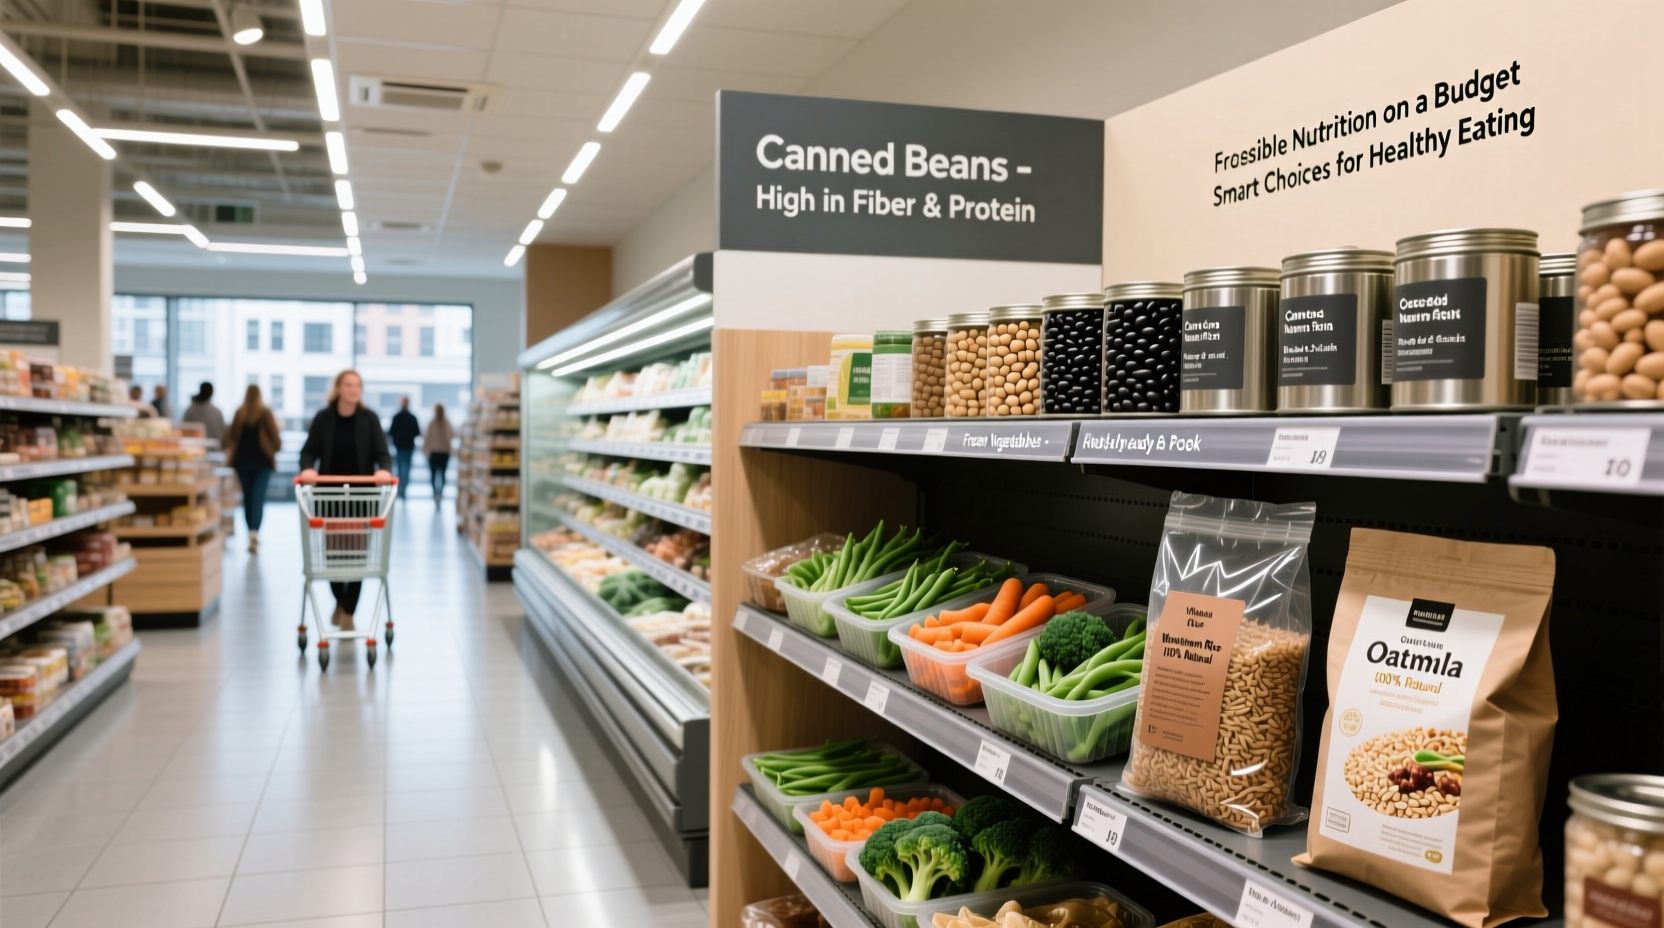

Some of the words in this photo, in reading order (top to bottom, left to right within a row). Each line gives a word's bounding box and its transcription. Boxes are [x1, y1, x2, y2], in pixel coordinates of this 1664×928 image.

[1292, 110, 1377, 152] Nutrition
[1383, 99, 1409, 124] on
[1415, 94, 1428, 114] a
[1434, 60, 1521, 109] Budget
[756, 134, 895, 176] Canned
[905, 144, 1008, 182] Beans
[1213, 177, 1260, 207] Smart
[1264, 161, 1331, 194] Choices
[1336, 151, 1364, 176] for
[1369, 127, 1452, 168] Healthy
[1458, 106, 1536, 146] Eating
[756, 184, 815, 217] High
[823, 188, 845, 212] in
[853, 189, 916, 216] Fiber
[922, 192, 941, 218] &
[949, 194, 1036, 222] Protein
